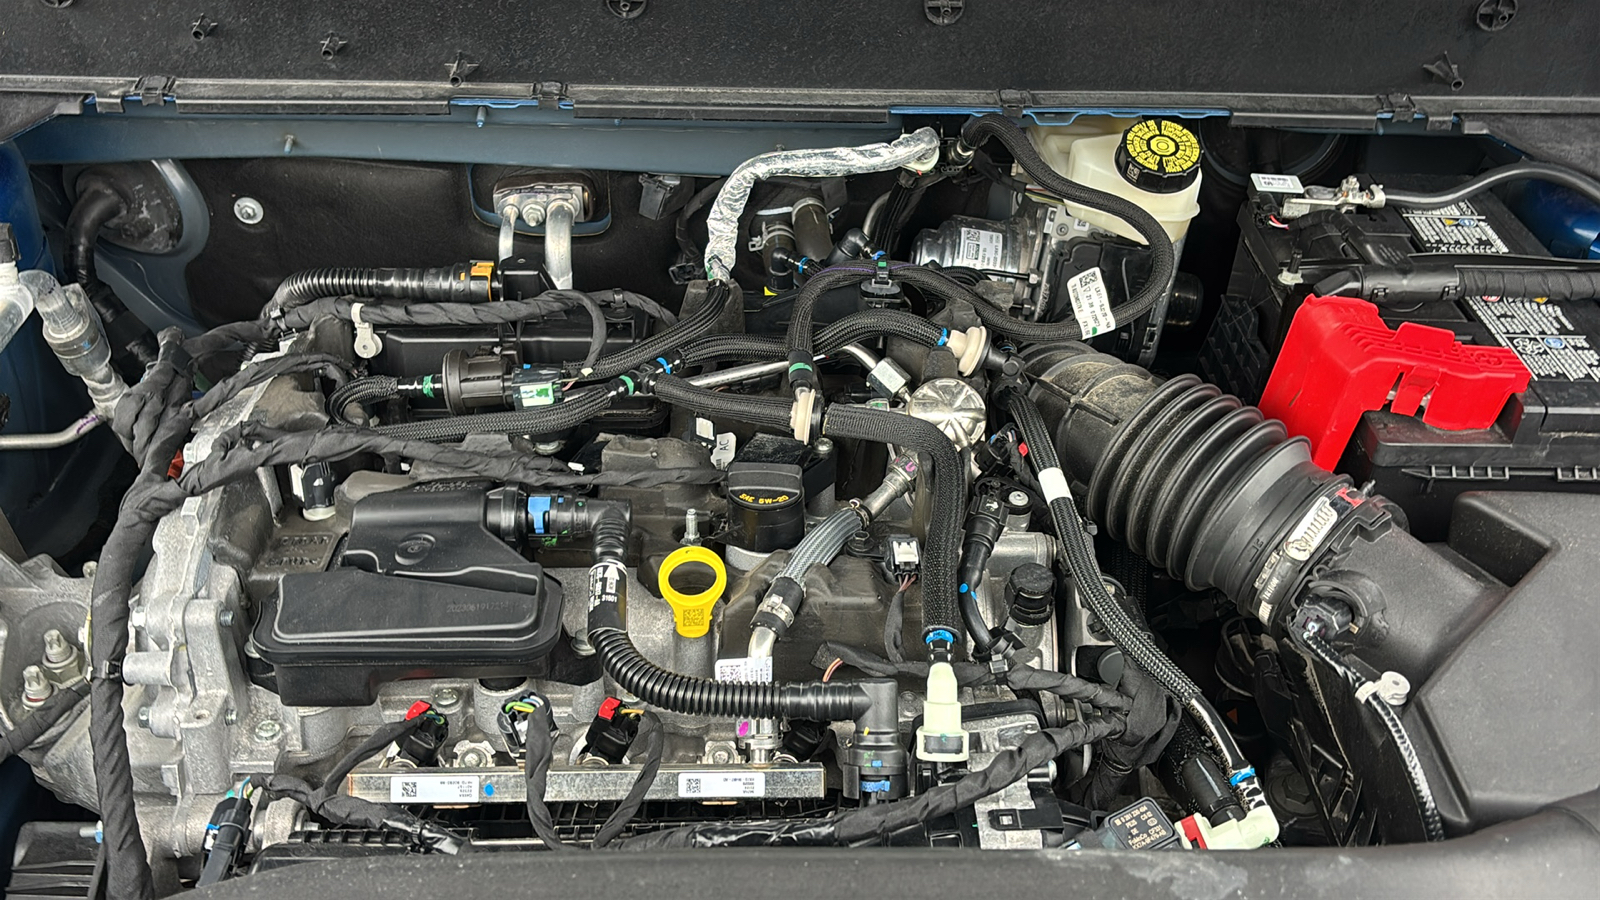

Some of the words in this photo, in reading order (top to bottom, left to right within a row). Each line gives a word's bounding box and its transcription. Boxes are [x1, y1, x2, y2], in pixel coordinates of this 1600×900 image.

[719, 439, 730, 450] AC
[738, 493, 755, 503] SAE
[758, 494, 790, 504] 5W-20
